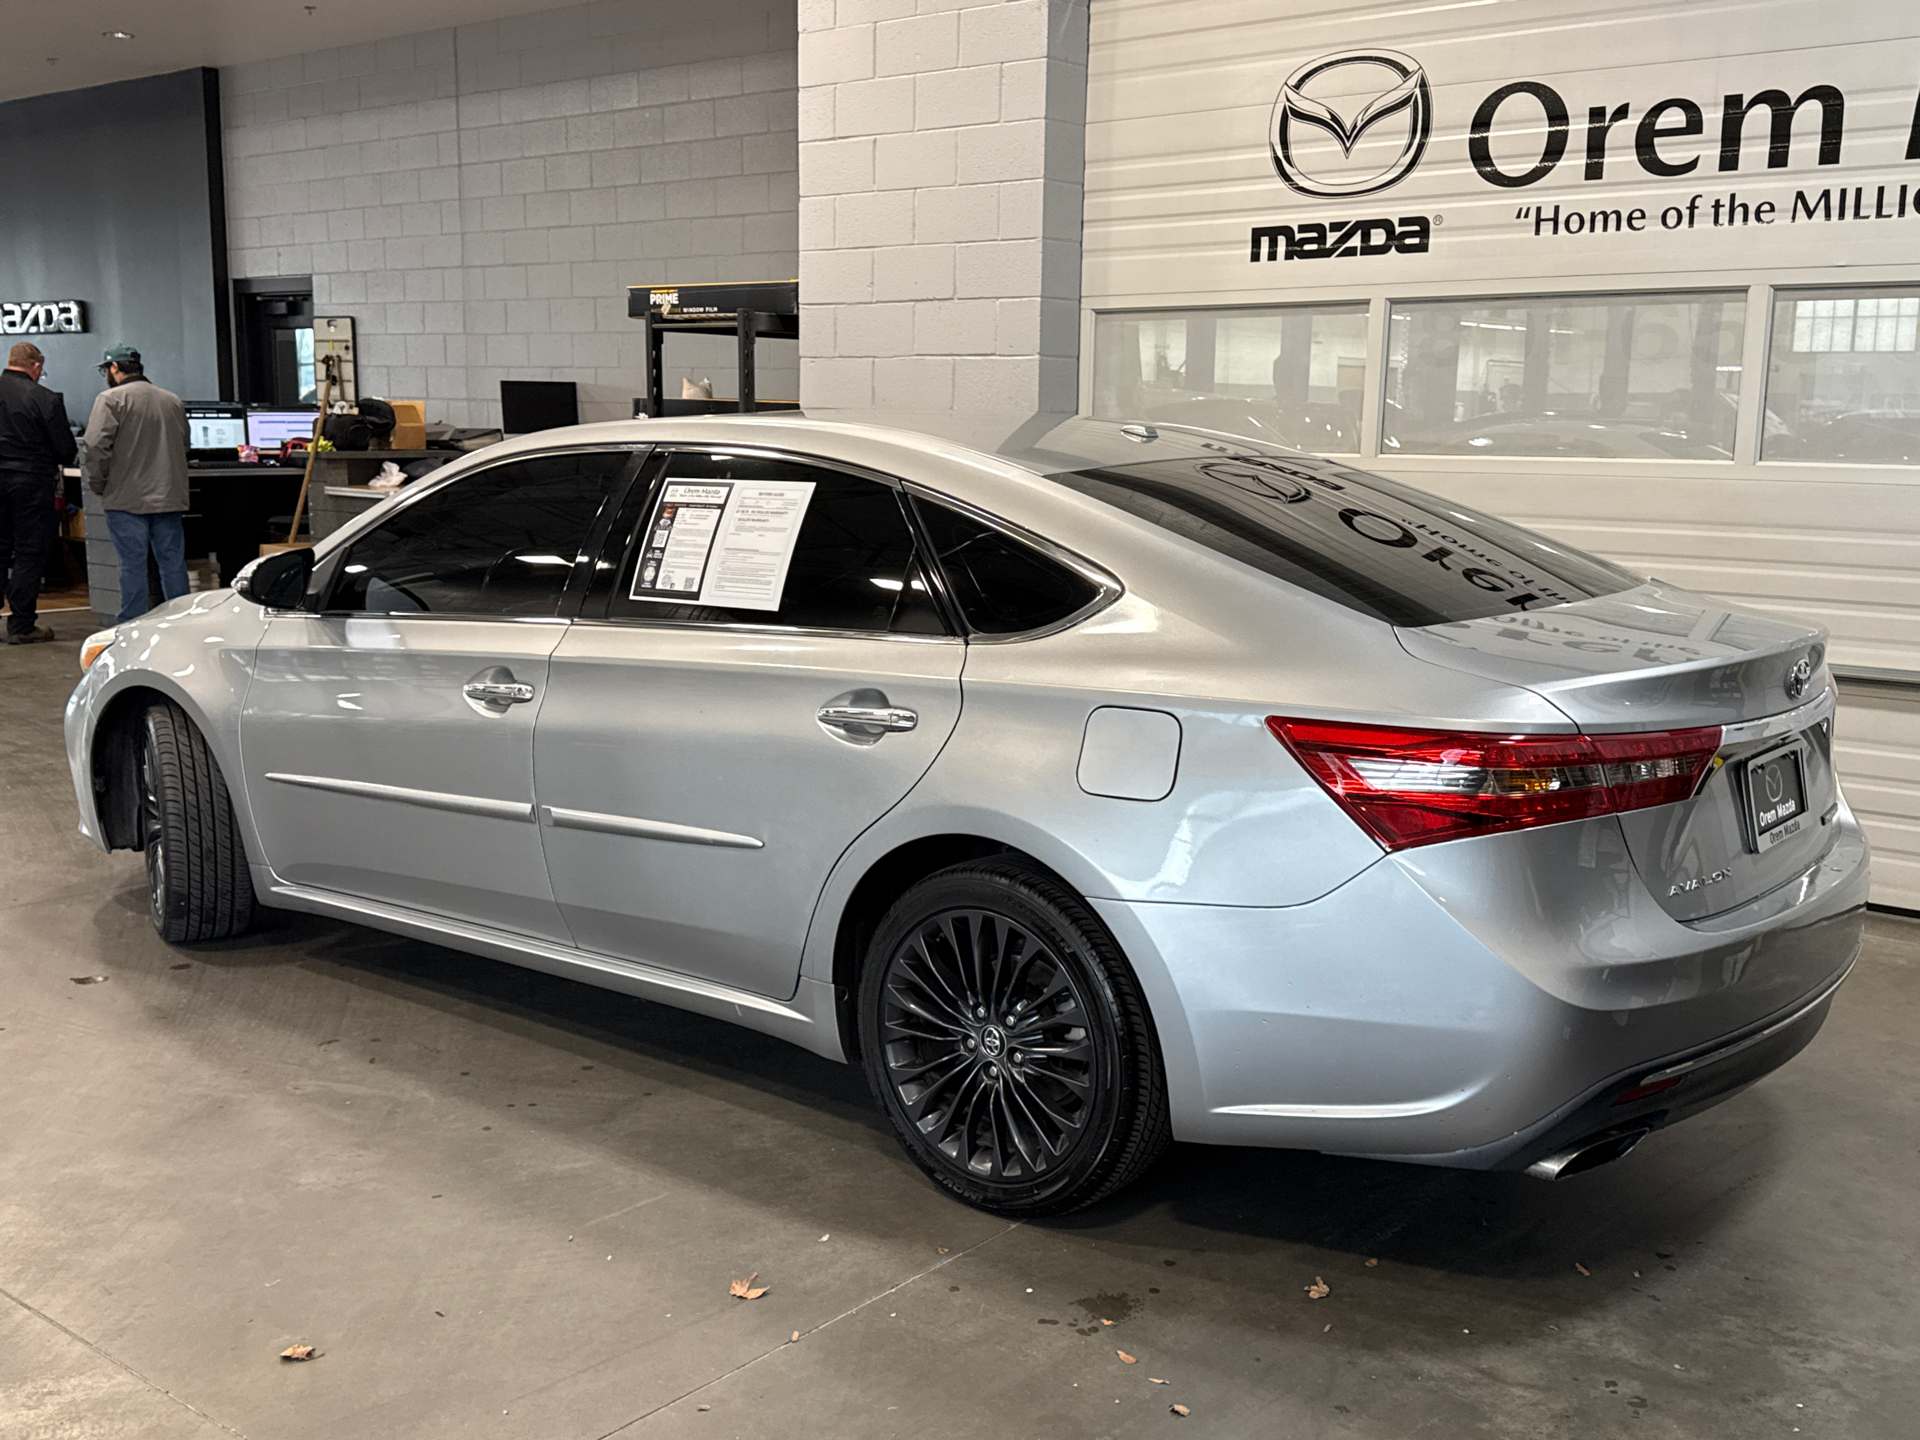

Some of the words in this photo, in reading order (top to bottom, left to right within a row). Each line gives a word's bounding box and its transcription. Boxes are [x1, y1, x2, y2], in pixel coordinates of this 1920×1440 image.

[1469, 82, 1845, 188] Orem
[1661, 194, 1703, 230] of
[1711, 193, 1776, 227] the
[1791, 184, 1920, 223] MILLI
[650, 293, 679, 305] PRIME
[0, 301, 81, 334] azda
[1759, 809, 1777, 827] Orem
[1776, 797, 1796, 819] Mazda
[1769, 829, 1784, 845] Orem
[1783, 819, 1801, 838] Mazda
[1669, 866, 1732, 897] AVALON
